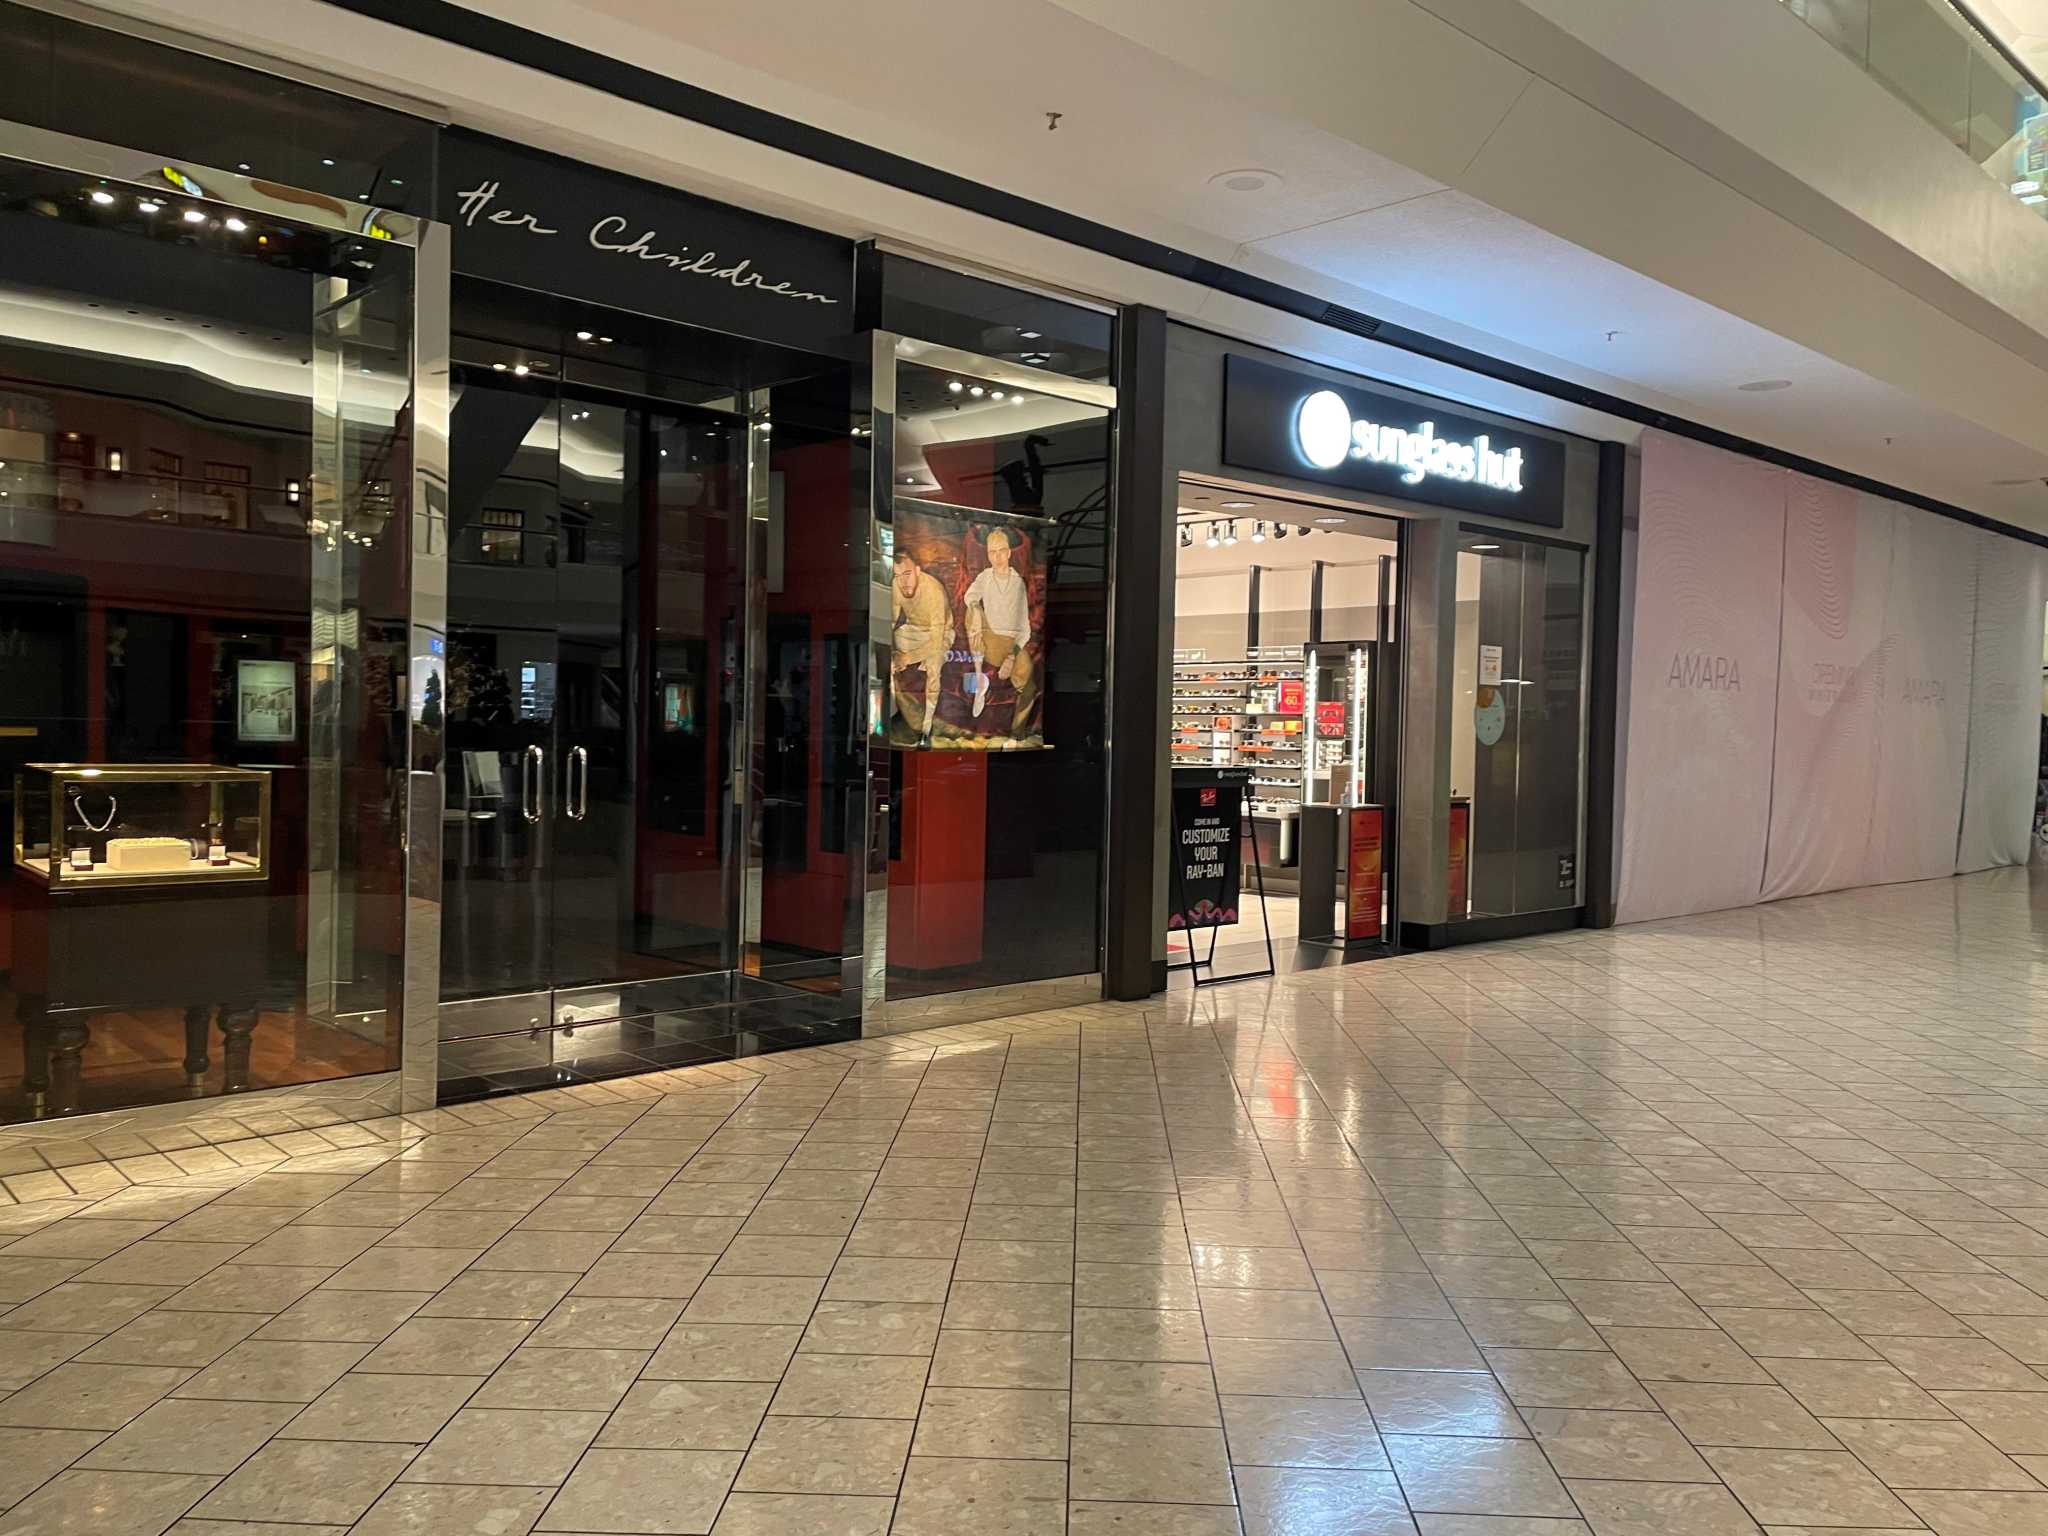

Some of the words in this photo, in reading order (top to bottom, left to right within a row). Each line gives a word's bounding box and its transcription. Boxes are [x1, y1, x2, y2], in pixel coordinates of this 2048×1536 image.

[457, 181, 558, 235] Her
[589, 216, 838, 304] Children
[1667, 652, 1742, 692] AMARA
[1182, 827, 1231, 844] CUSTOMIZE
[1194, 846, 1218, 861] YOUR
[1186, 863, 1225, 880] RAY-BAN
